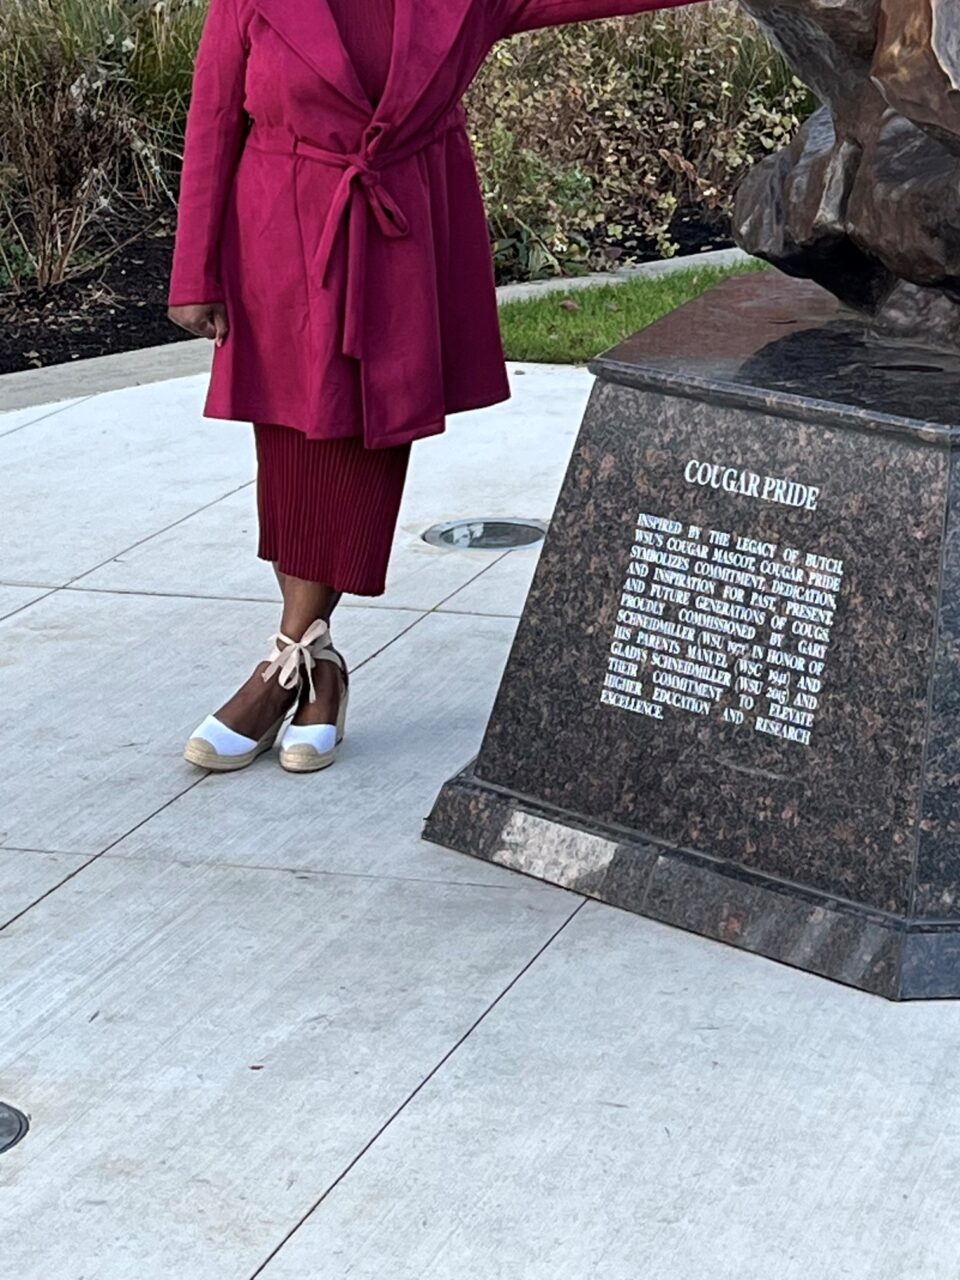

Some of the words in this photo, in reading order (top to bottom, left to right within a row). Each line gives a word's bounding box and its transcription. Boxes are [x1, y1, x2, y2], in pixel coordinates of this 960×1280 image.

[684, 459, 760, 498] COUGAR
[761, 476, 820, 510] PRIDE
[637, 513, 683, 535] INSPIRED
[687, 525, 702, 540] BY
[709, 529, 731, 547] THE
[736, 536, 777, 559] LEGACY
[782, 548, 799, 564] OF
[666, 537, 709, 559] COUGAR
[712, 547, 756, 573] MASCOT,
[760, 559, 804, 582] COUGAR
[808, 571, 841, 592] PRIDE
[623, 577, 645, 594] AND
[649, 583, 691, 606] FUTURE
[695, 595, 766, 626] GENERATIONS
[770, 614, 787, 630] OF
[626, 561, 649, 578] AND
[653, 567, 716, 595] INSPIRATION
[722, 585, 745, 603] FOR
[750, 592, 776, 613] PAST,
[785, 600, 833, 626] PRESENT,
[630, 545, 690, 571] SYMBOLIZES
[694, 561, 766, 592] COMMITMENT,
[771, 579, 837, 610] DEDICATION,
[616, 609, 696, 641] SCHNEIDMILLER
[697, 630, 725, 651] (WSU
[752, 644, 765, 659] IN
[766, 648, 806, 671] HONOR
[808, 660, 825, 676] OF
[620, 592, 666, 616] PROUDLY
[678, 608, 756, 640] COMMISSIONED
[769, 631, 785, 647] BY
[798, 639, 828, 659] GARY
[610, 641, 648, 661] GLADYS
[650, 652, 731, 687] SCHNEIDMILLER
[735, 675, 764, 695] (WSU
[793, 692, 818, 710] AND
[613, 624, 631, 641] HIS
[636, 631, 680, 654] PARENTS
[686, 644, 728, 668] MANUEL
[734, 658, 763, 678] (WSC
[796, 675, 821, 693] AND
[600, 689, 664, 720] EXCELLENCE.
[603, 672, 642, 696] HIGHER
[652, 686, 711, 715] EDUCATION
[723, 707, 744, 725] AND
[755, 716, 811, 746] RESEARCH
[608, 657, 638, 677] THEIR
[652, 670, 723, 702] COMMITMENT
[738, 693, 755, 710] TO
[768, 702, 815, 727] ELEVATE
